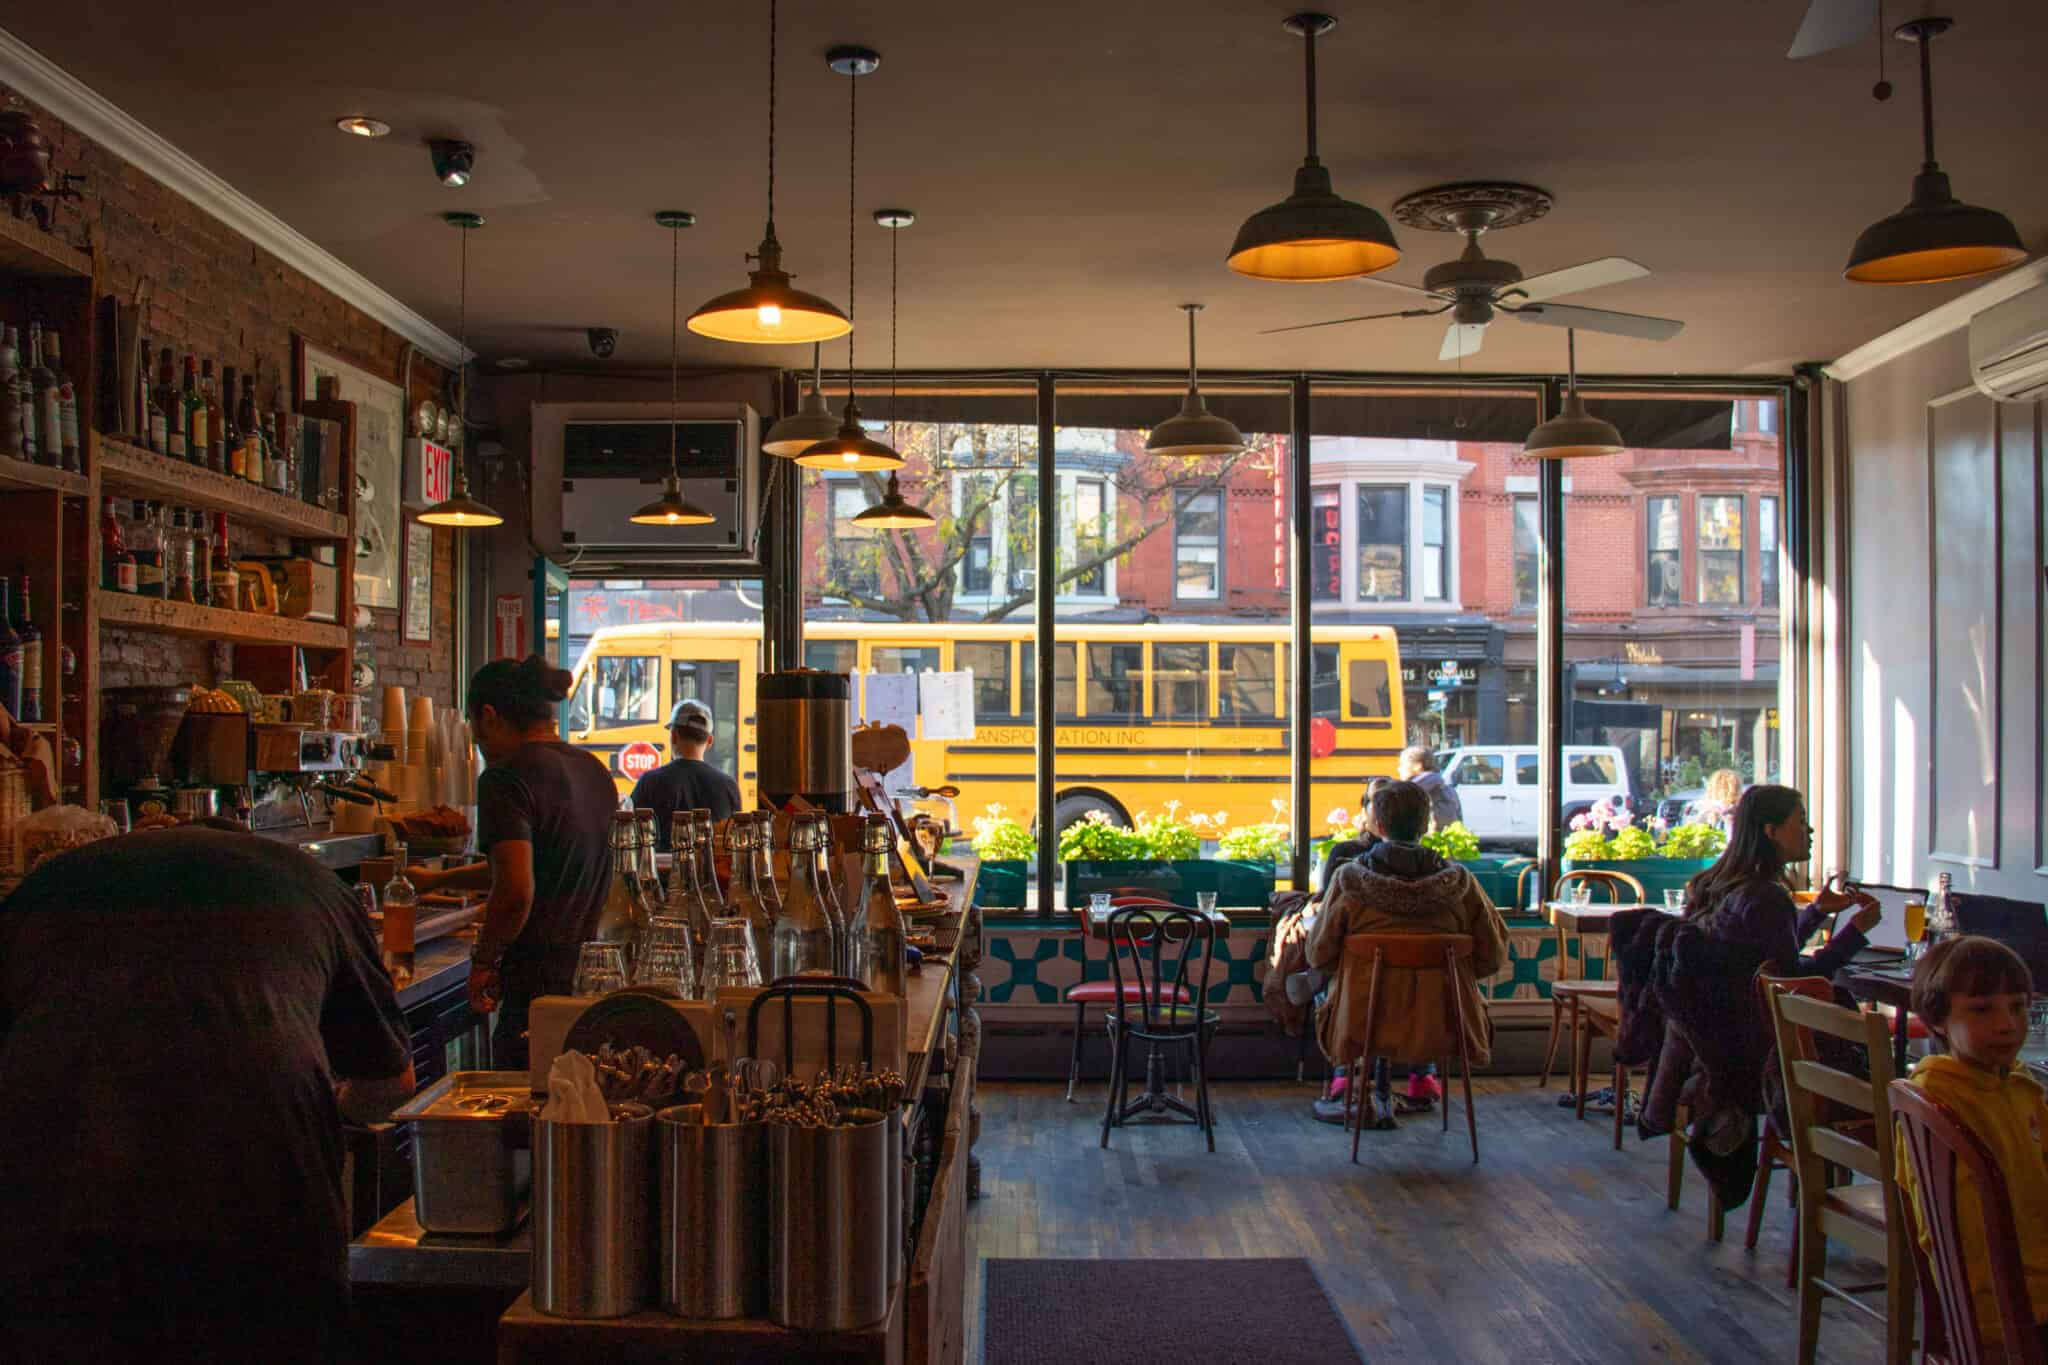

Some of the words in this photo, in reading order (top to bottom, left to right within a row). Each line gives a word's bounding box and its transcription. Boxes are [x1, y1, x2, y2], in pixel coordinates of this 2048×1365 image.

[425, 445, 450, 502] EXIT
[957, 729, 1111, 745] ANSPOATION
[626, 754, 656, 770] STOP
